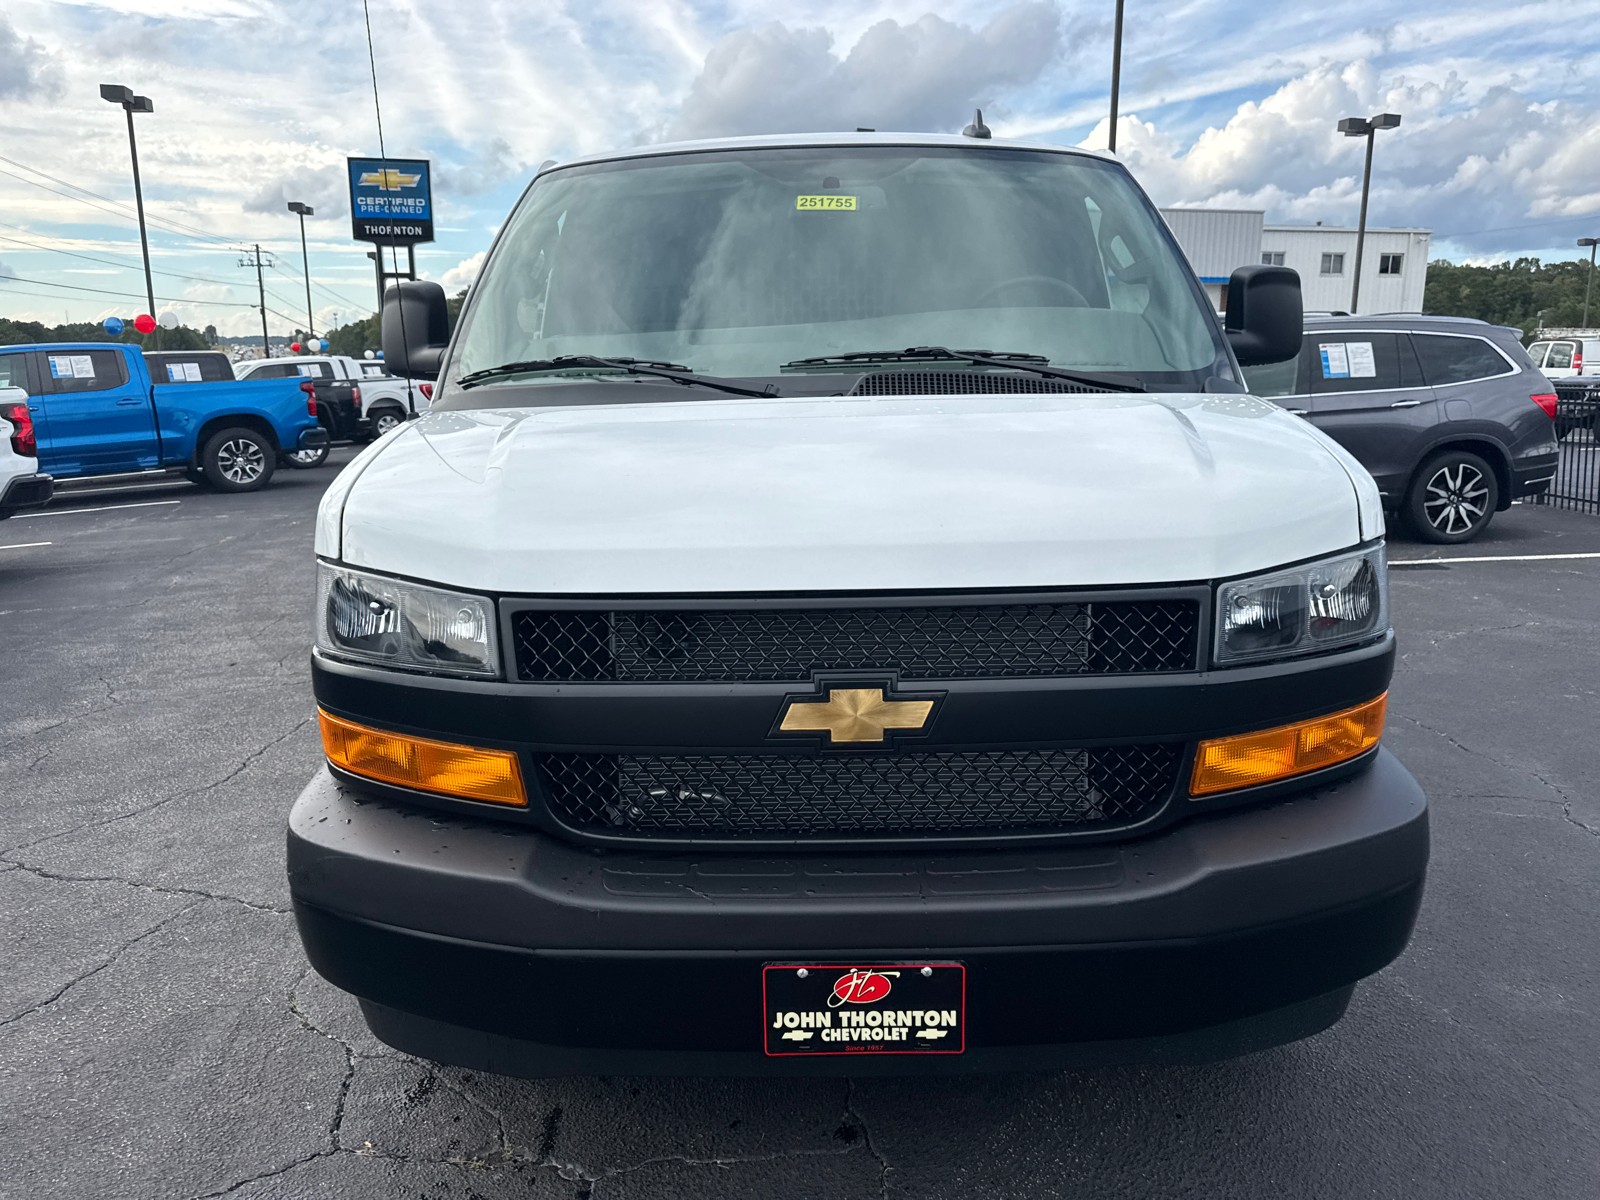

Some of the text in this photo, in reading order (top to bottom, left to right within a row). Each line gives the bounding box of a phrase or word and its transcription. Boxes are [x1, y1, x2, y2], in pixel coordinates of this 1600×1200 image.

[357, 196, 426, 206] CERTIFIED
[799, 197, 853, 208] 251755
[361, 205, 423, 214] PRE-OWNED
[773, 1010, 957, 1029] JOHN THORNTON
[821, 1027, 908, 1041] CHEVROLET
